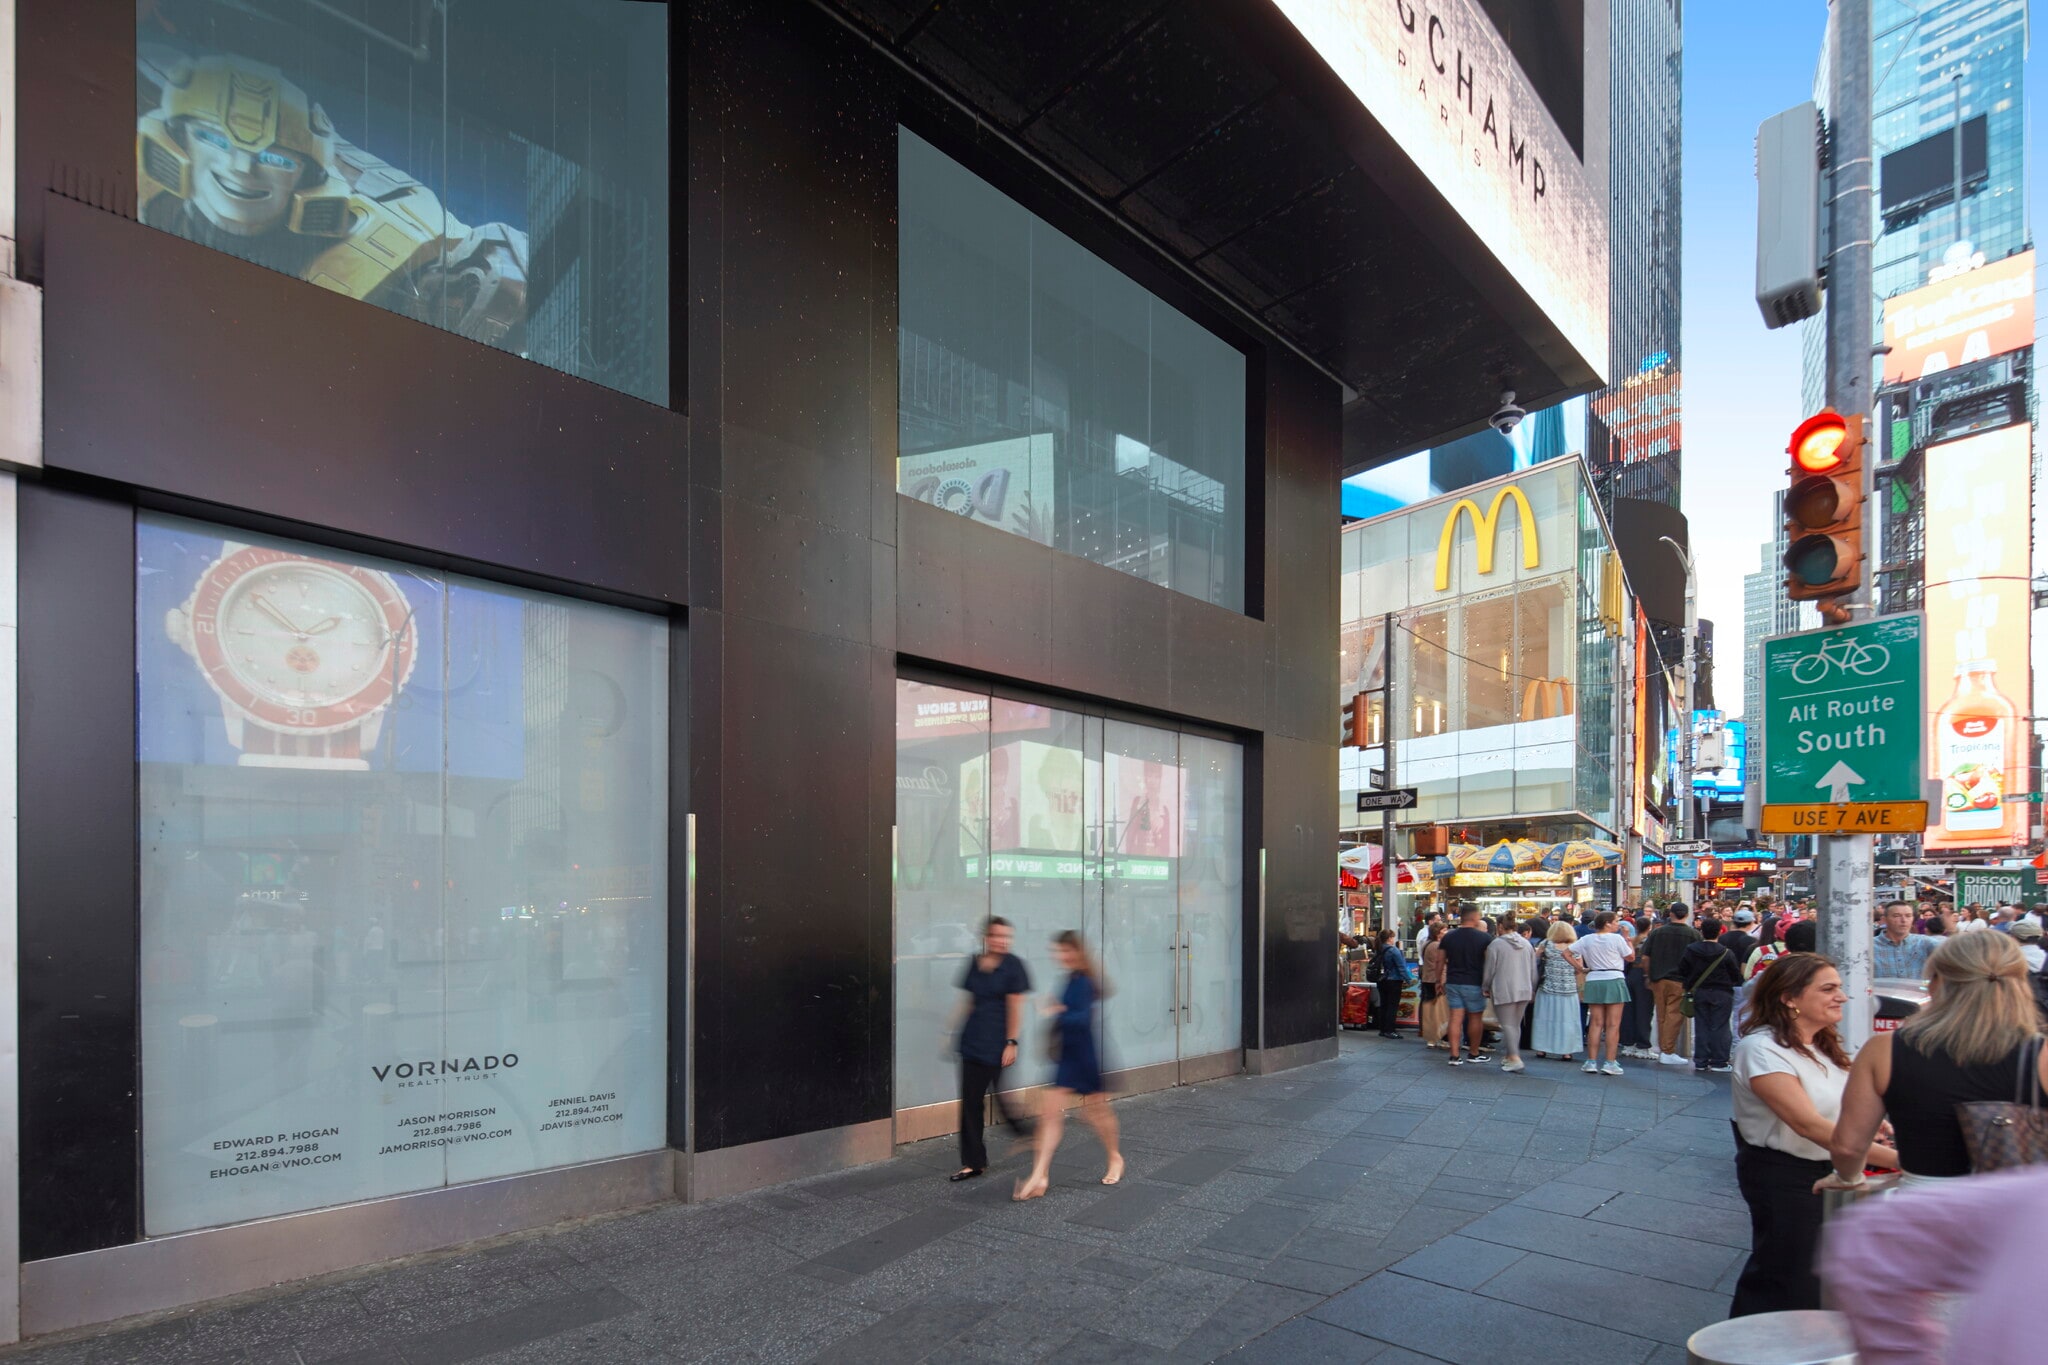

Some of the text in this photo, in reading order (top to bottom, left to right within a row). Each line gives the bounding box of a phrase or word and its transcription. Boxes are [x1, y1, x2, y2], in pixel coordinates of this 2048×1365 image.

[1397, 48, 1481, 168] PARIS
[1788, 695, 1895, 723] Alt Route
[1796, 723, 1886, 753] South
[1365, 795, 1408, 806] ONE WAY
[1793, 809, 1891, 826] USE 7 AVE
[371, 1053, 519, 1082] VORNADO
[398, 1072, 498, 1088] REALTY TRUST
[548, 1092, 616, 1107] JENNIEL DAVIS
[397, 1107, 496, 1127] JASON MORRISON
[555, 1104, 609, 1118] 212.894.7411
[413, 1121, 482, 1138] 212.894.7986
[539, 1113, 623, 1131] JDAVIS@VNO.COM
[213, 1127, 339, 1151] EDWARD P. HOGAN
[378, 1128, 512, 1155] JAMORRISON@VNO.COM
[235, 1142, 319, 1161] 212.894.7988
[209, 1152, 342, 1179] EHOGAN@VNO.COM
